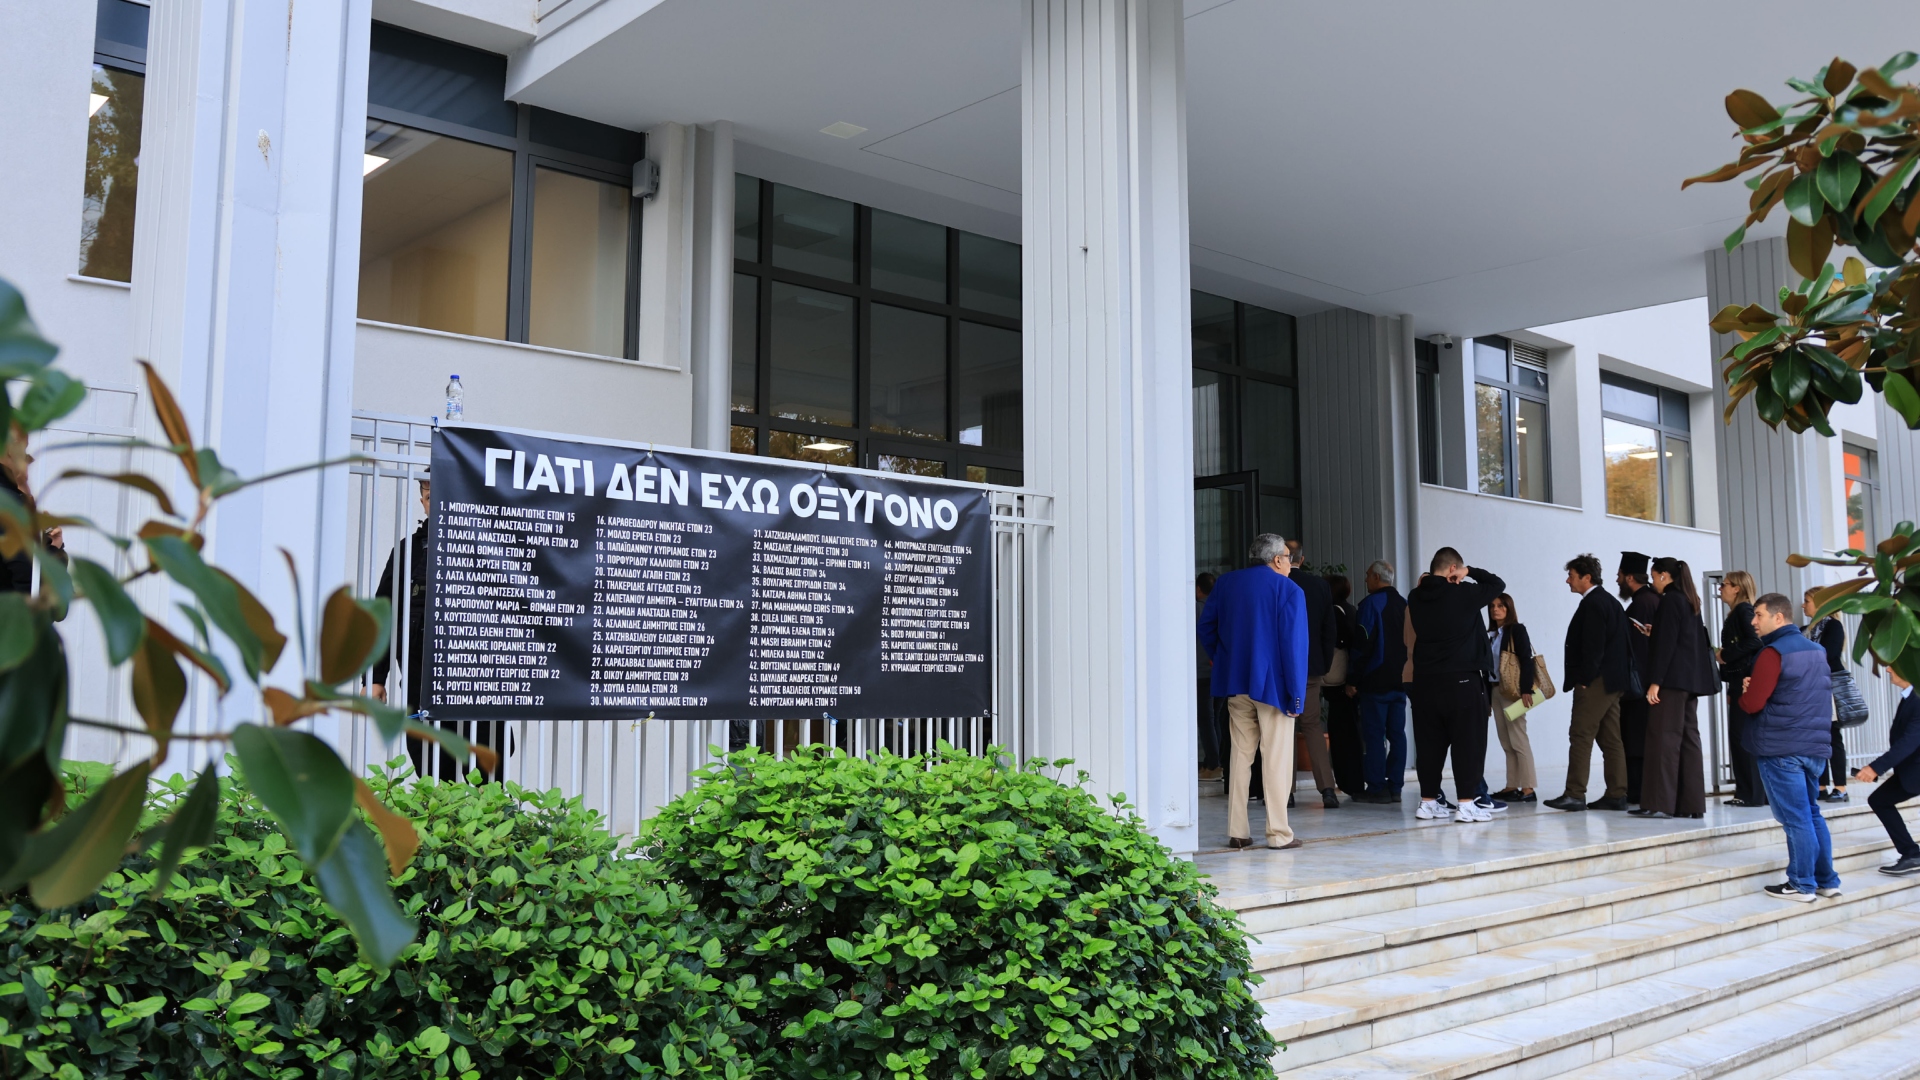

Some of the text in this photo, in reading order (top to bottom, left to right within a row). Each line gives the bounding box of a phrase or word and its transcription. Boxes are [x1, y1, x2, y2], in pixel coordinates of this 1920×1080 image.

[484, 447, 959, 531] ΓΙΑΤΙ ΔΕΝ ΕΧΩ ΟΞΥΓΟΝΟ
[440, 502, 575, 522] 1. ΜΠΟΥΡΝΑΖΗΣ ΠΑΝΑΓΙΩΤΗΣ ΕΤΩΝ 15
[438, 515, 563, 534] 2. ΠΑΠΑΓΓΕΛΗ ΑΝΑΣΤΑΣΙΑ ΕΤΩΝ 18
[596, 515, 712, 533] 16. ΚΑΡΑΘΕΟΔΩΡΟΥ ΝΙΚΗΤΑΣ ΕΤΩΝ 23
[596, 528, 681, 543] 17. ΜΟΛΧΟ ΕΡΙΕΤΑ ΕΤΩΝ 23
[436, 543, 536, 558] 4. ΠΛΑΚΙΑ ΘΩΜΑΗ ΕΤΩΝ 20
[595, 541, 716, 558] 18. ΠΑΠΑΪΩΑΝΝΟΥ ΚΥΠΡΙΑΝΟΣ ΕΤΩΝ 23
[436, 556, 531, 571] 5. ΠΛΑΚΙΑ ΧΡΥΣΗ ΕΤΩΝ 20
[595, 554, 709, 570] 19. ΠΟΡΦΥΡΙΔΟΥ ΚΑΛΛΙΟΠΗ ΕΤΩΝ 23
[436, 570, 538, 585] 6. ΛΑΤΑ ΚΛΑΟΥΝΤΙΑ ΕΤΩΝ 20
[595, 567, 690, 581] 20. ΤΣΑΚΛΙΔΟΥ ΑΓΑΠΗ ΕΤΩΝ 23
[435, 584, 555, 599] 7. ΜΠΡΕΖΑ ΦΡΑΝΤΣΕΣΚΑ ΕΤΩΝ 20
[594, 580, 701, 594] 21. ΤΗΛΚΕΡΙΔΗΣ ΑΓΓΕΛΟΣ ΕΤΩΝ 23
[434, 612, 572, 626] 9. ΚΟΥΤΣΟΠΟΥΛΟΣ ΑΝΑΣΤΑΣΙΟΣ ΕΤΩΝ 21
[593, 606, 697, 619] 23. ΑΔΑΜΙΔΗ ΑΝΑΣΤΑΣΙΑ ΕΤΩΝ 24
[434, 626, 534, 638] 10. ΤΣΙΝΤΖΑ ΕΛΕΝΗ ΕΤΩΝ 21
[434, 640, 556, 652] 11. ΑΔΑΜΑΚΗΣ ΙΟΡΔΑΝΗΣ ΕΤΩΝ 22
[433, 653, 547, 665] 12. ΜΗΤΣΚΑ ΙΦΙΓΕΝΕΙΑ ΕΤΩΝ 22
[433, 667, 560, 678] 13. ΠΑΠΑΖΟΓΛΟΥ ΓΕΩΡΓΙΟΣ ΕΤΩΝ 22
[590, 671, 688, 680] 28. ΟΙΚΟΥ ΔΗΜΗΤΡΙΟΣ ΕΤΩΝ 28
[432, 681, 530, 691] 14. ΡΟΥΤΣΙ ΝΤΕΝΙΣ ΕΤΩΝ 22
[590, 684, 677, 693] 29. ΧΟΥΠΑ ΕΛΠΙΔΑ ΕΤΩΝ 28
[432, 695, 544, 705] 15. ΤΣΙΩΜΑ ΑΦΡΟΔΙΤΗ ΕΤΩΝ 22
